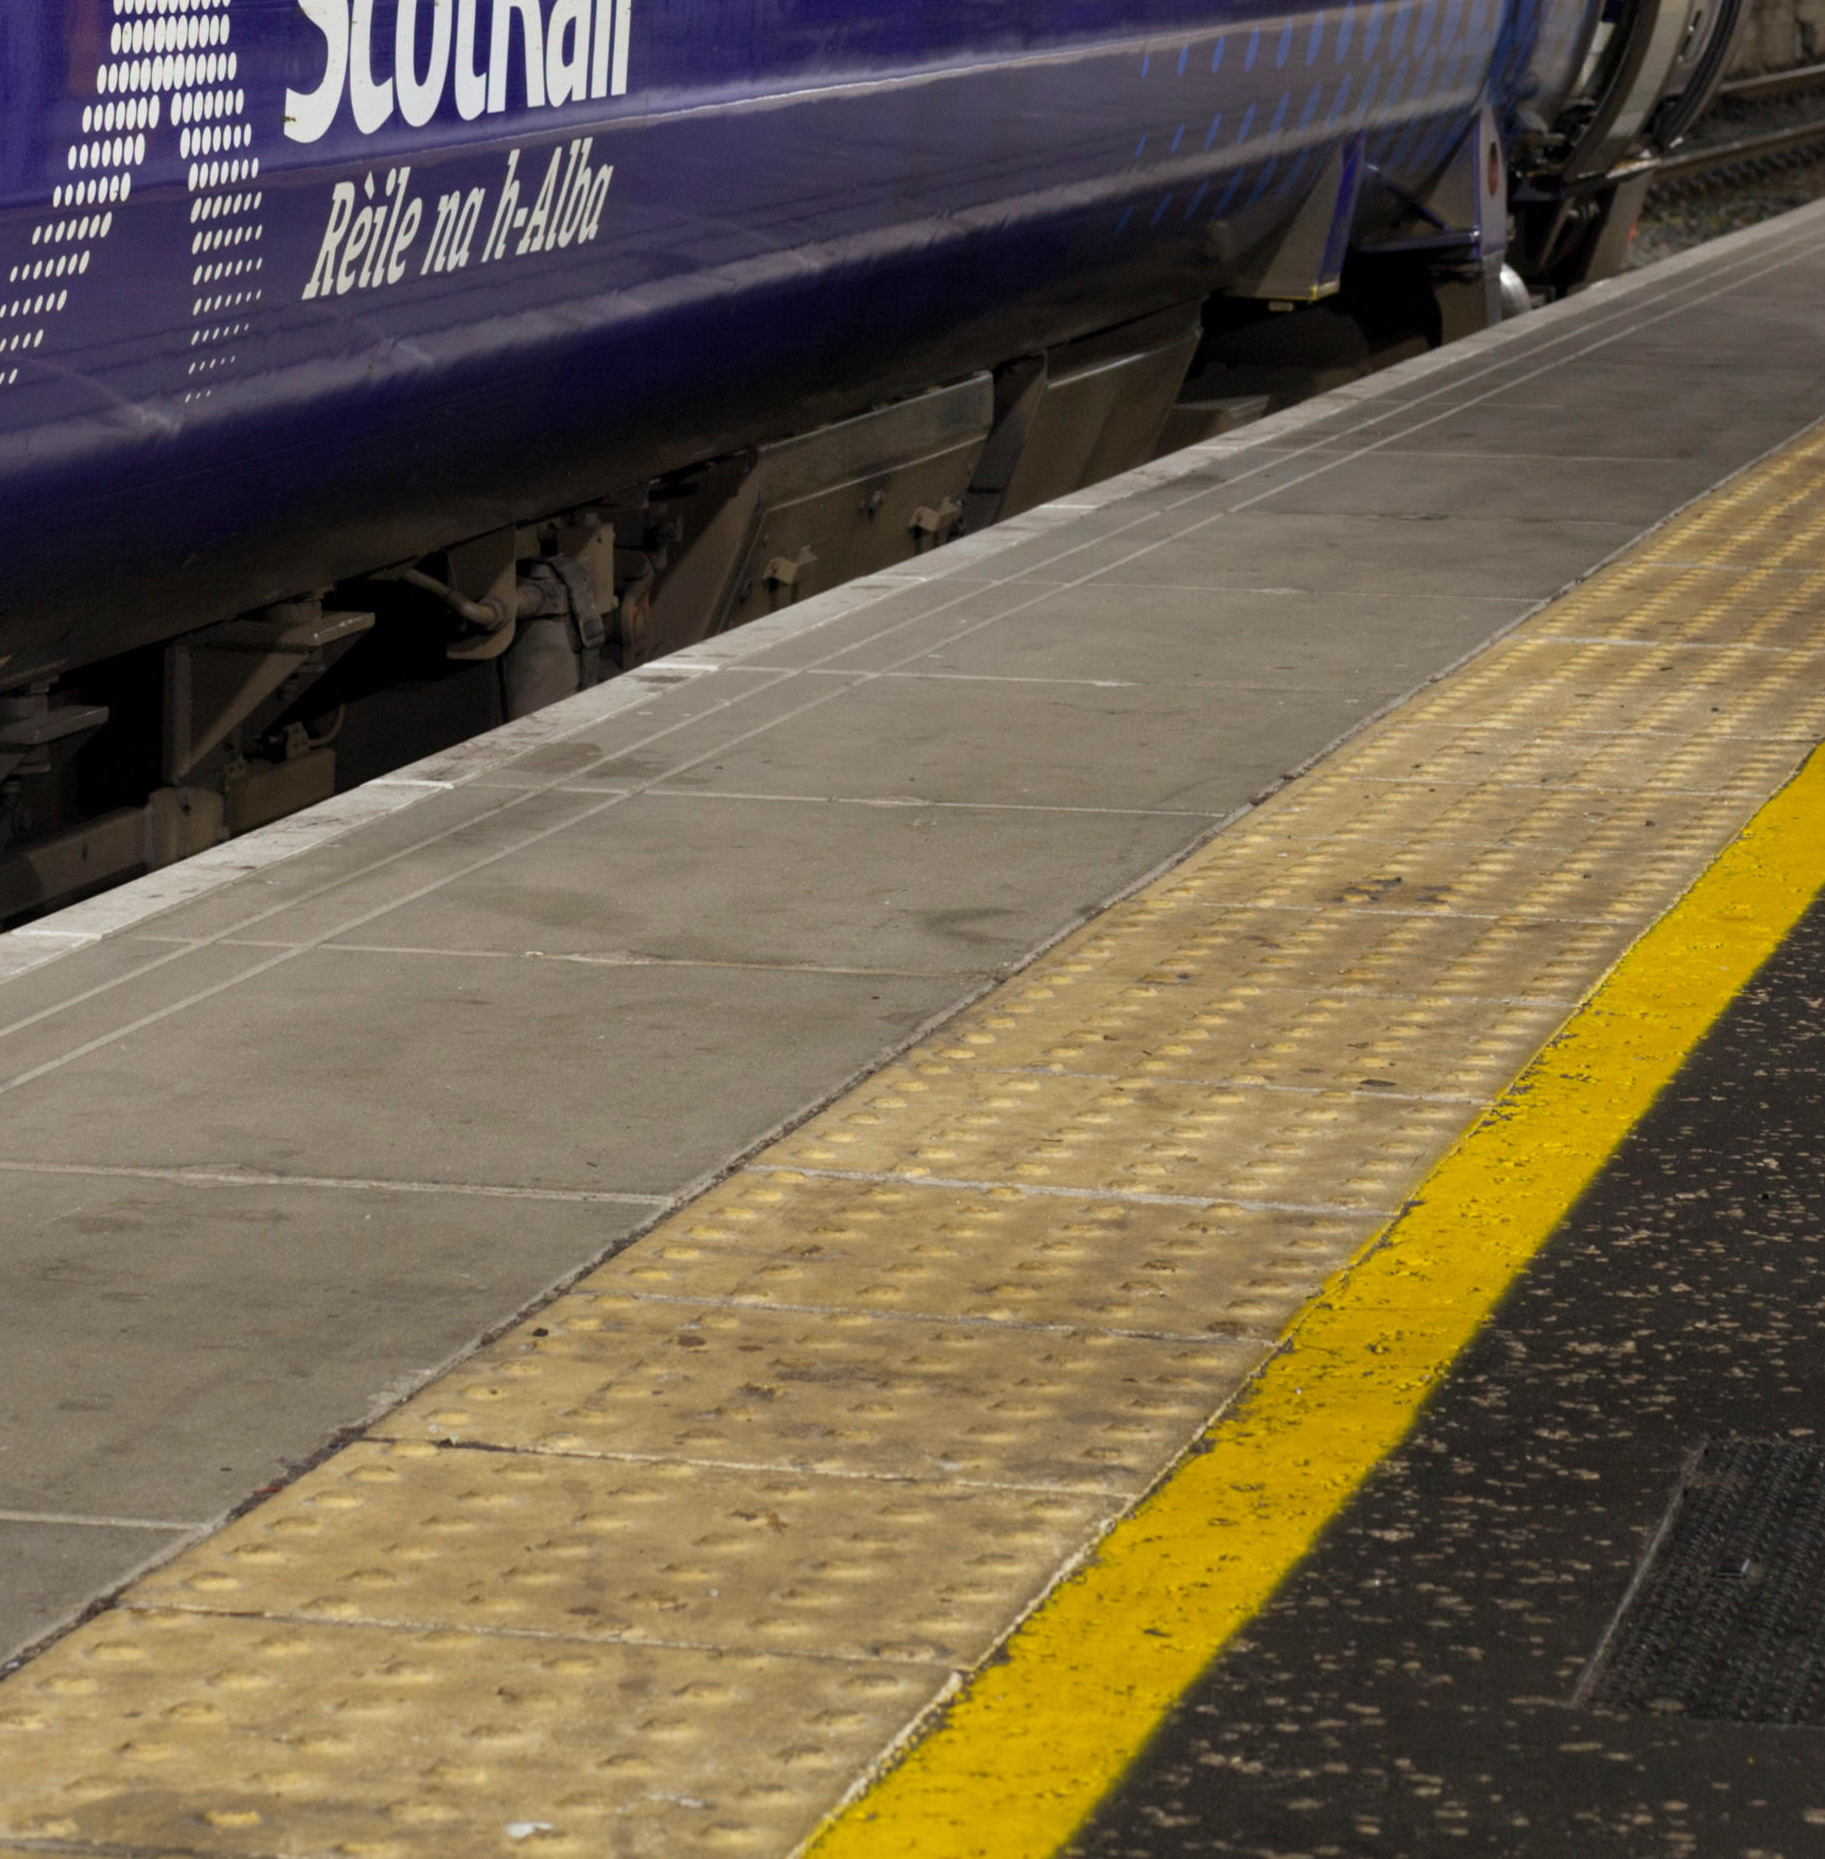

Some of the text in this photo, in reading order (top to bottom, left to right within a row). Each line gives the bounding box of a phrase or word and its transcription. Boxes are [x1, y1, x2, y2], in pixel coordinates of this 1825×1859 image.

[302, 137, 614, 300] Rèile na h-Alba
